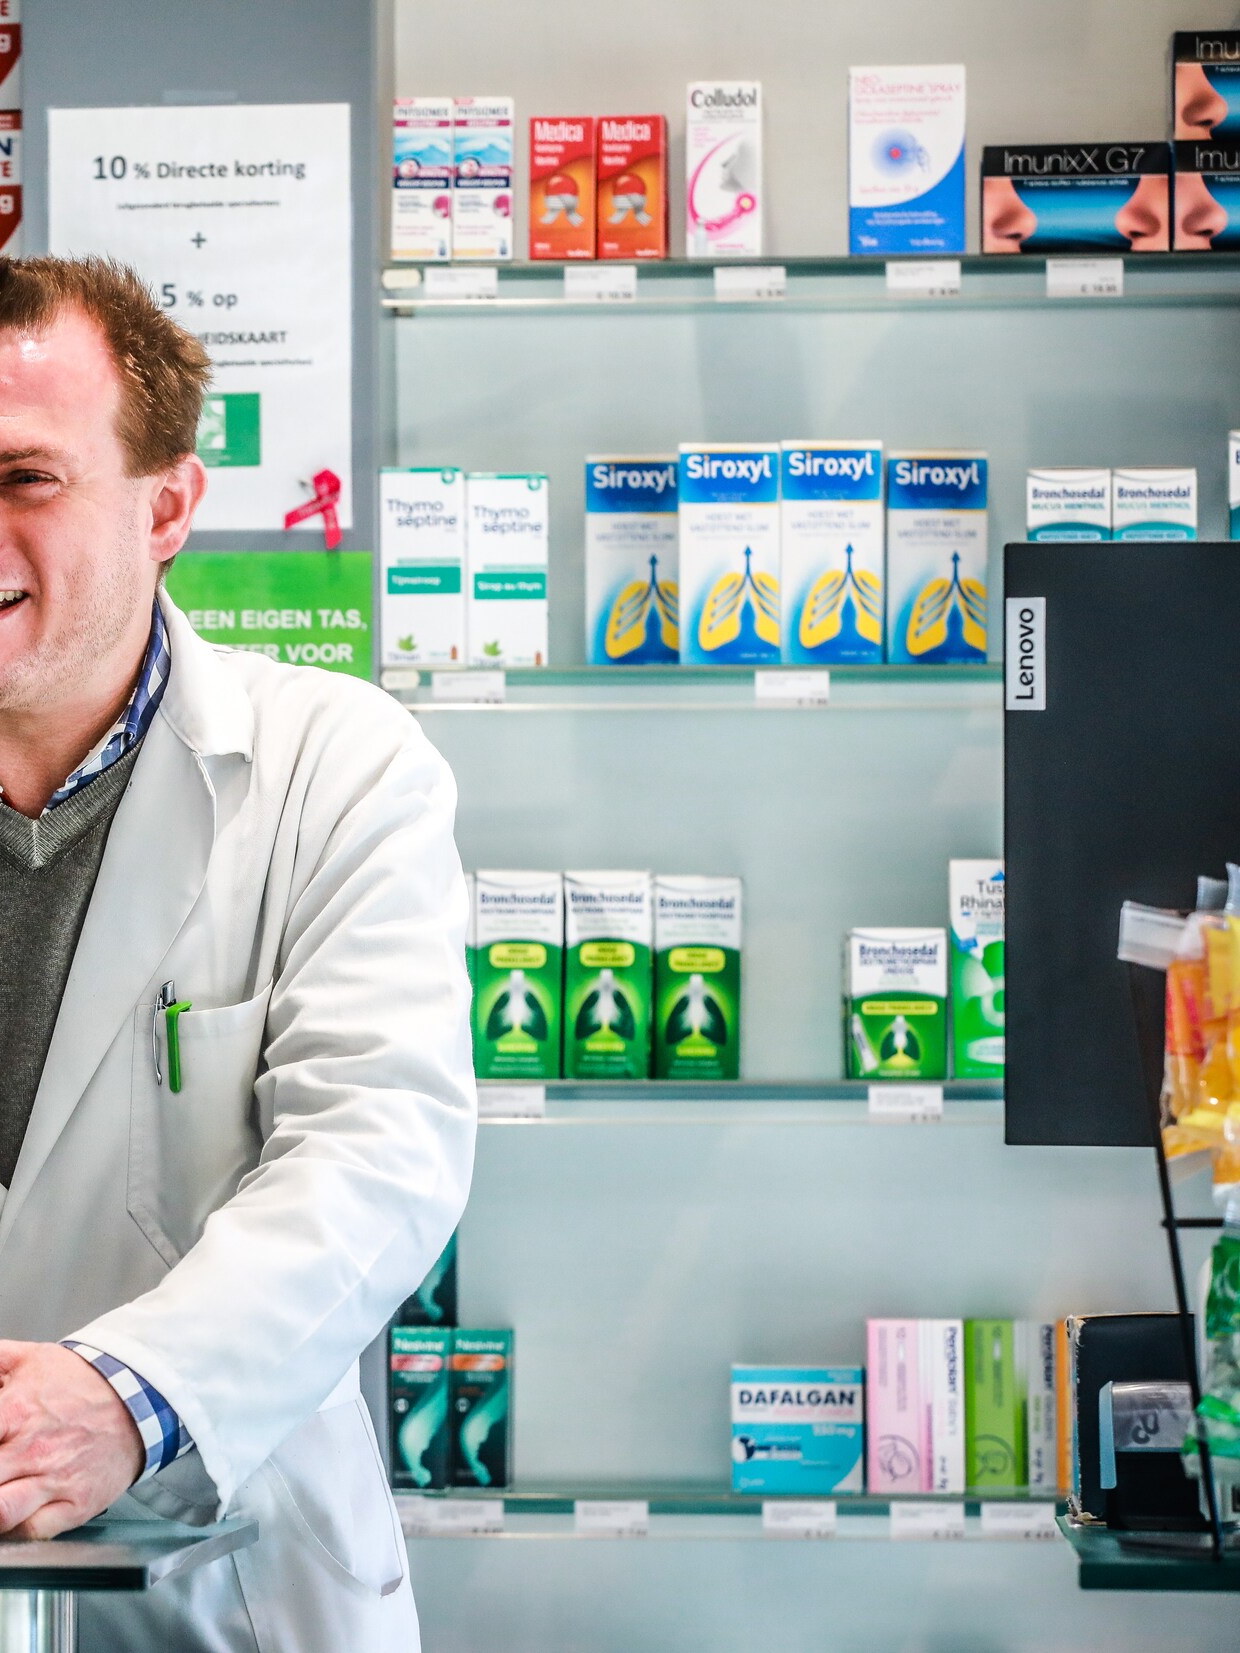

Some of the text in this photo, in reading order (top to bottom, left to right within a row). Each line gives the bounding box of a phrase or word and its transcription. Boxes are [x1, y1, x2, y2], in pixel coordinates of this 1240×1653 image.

[1196, 36, 1240, 59] Imu
[691, 88, 757, 108] Colludol
[534, 121, 584, 142] Medica
[602, 120, 651, 141] Medica
[93, 157, 306, 180] 10 % Directe korting
[1106, 147, 1145, 172] G7
[1196, 145, 1240, 170] Imu
[162, 285, 238, 310] 5 % op
[687, 455, 772, 483] Siroxyl
[789, 452, 874, 480] Siroxyl
[896, 462, 979, 490] Siroxyl
[593, 465, 676, 492] Siroxyl
[1032, 487, 1105, 499] Bronchosedal
[1118, 486, 1191, 499] Bronchosedal
[387, 499, 444, 514] Thymo
[474, 505, 530, 520] Thymo
[241, 609, 312, 629] EIGEN
[317, 608, 368, 631] TAS,
[285, 643, 354, 663] VOOR
[1015, 608, 1035, 700] Lenovo
[976, 880, 1004, 894] Tus
[961, 895, 1004, 909] Rhina
[739, 1390, 855, 1406] DAFALGAN
